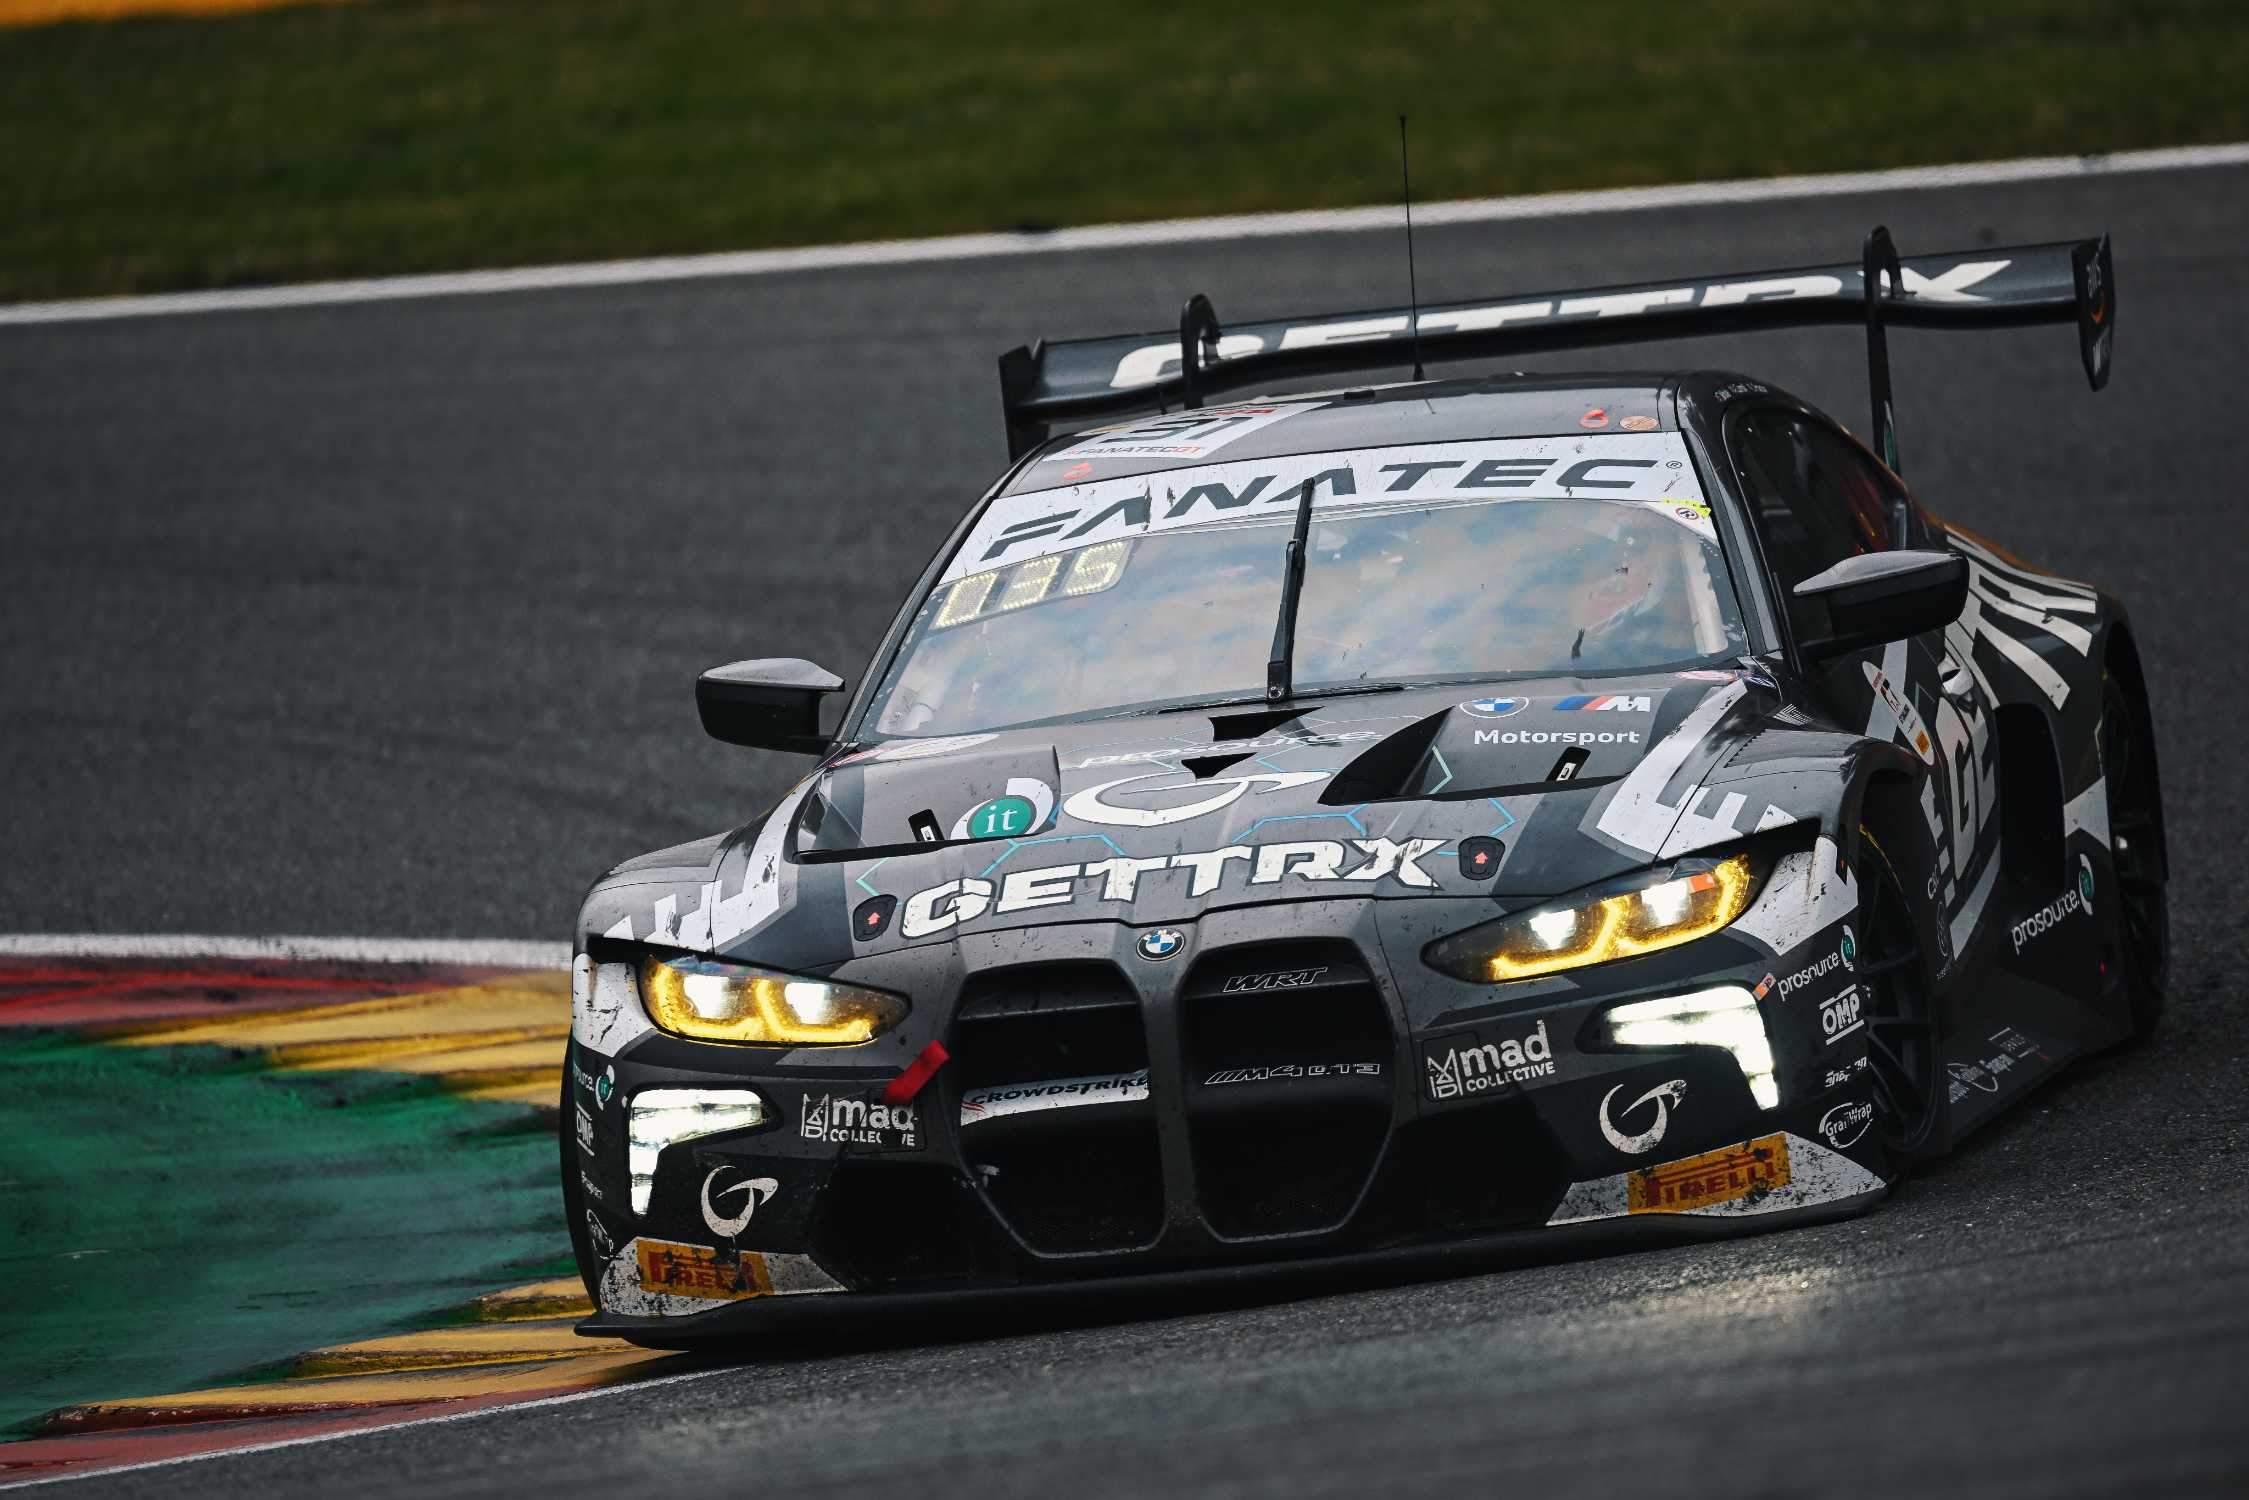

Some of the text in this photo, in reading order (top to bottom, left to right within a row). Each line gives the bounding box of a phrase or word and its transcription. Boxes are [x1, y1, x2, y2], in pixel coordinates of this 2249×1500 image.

[979, 458, 1658, 562] FANATEC
[1474, 729, 1640, 746] Motorsport
[984, 804, 1018, 834] it
[902, 838, 1446, 938] GETTRX
[1222, 966, 1328, 993] WRT
[1822, 992, 1860, 1035] OMP
[1460, 1019, 1552, 1077] mad
[1465, 1061, 1556, 1092] COLLECTIVE
[1644, 1147, 1776, 1208] PIRELLI
